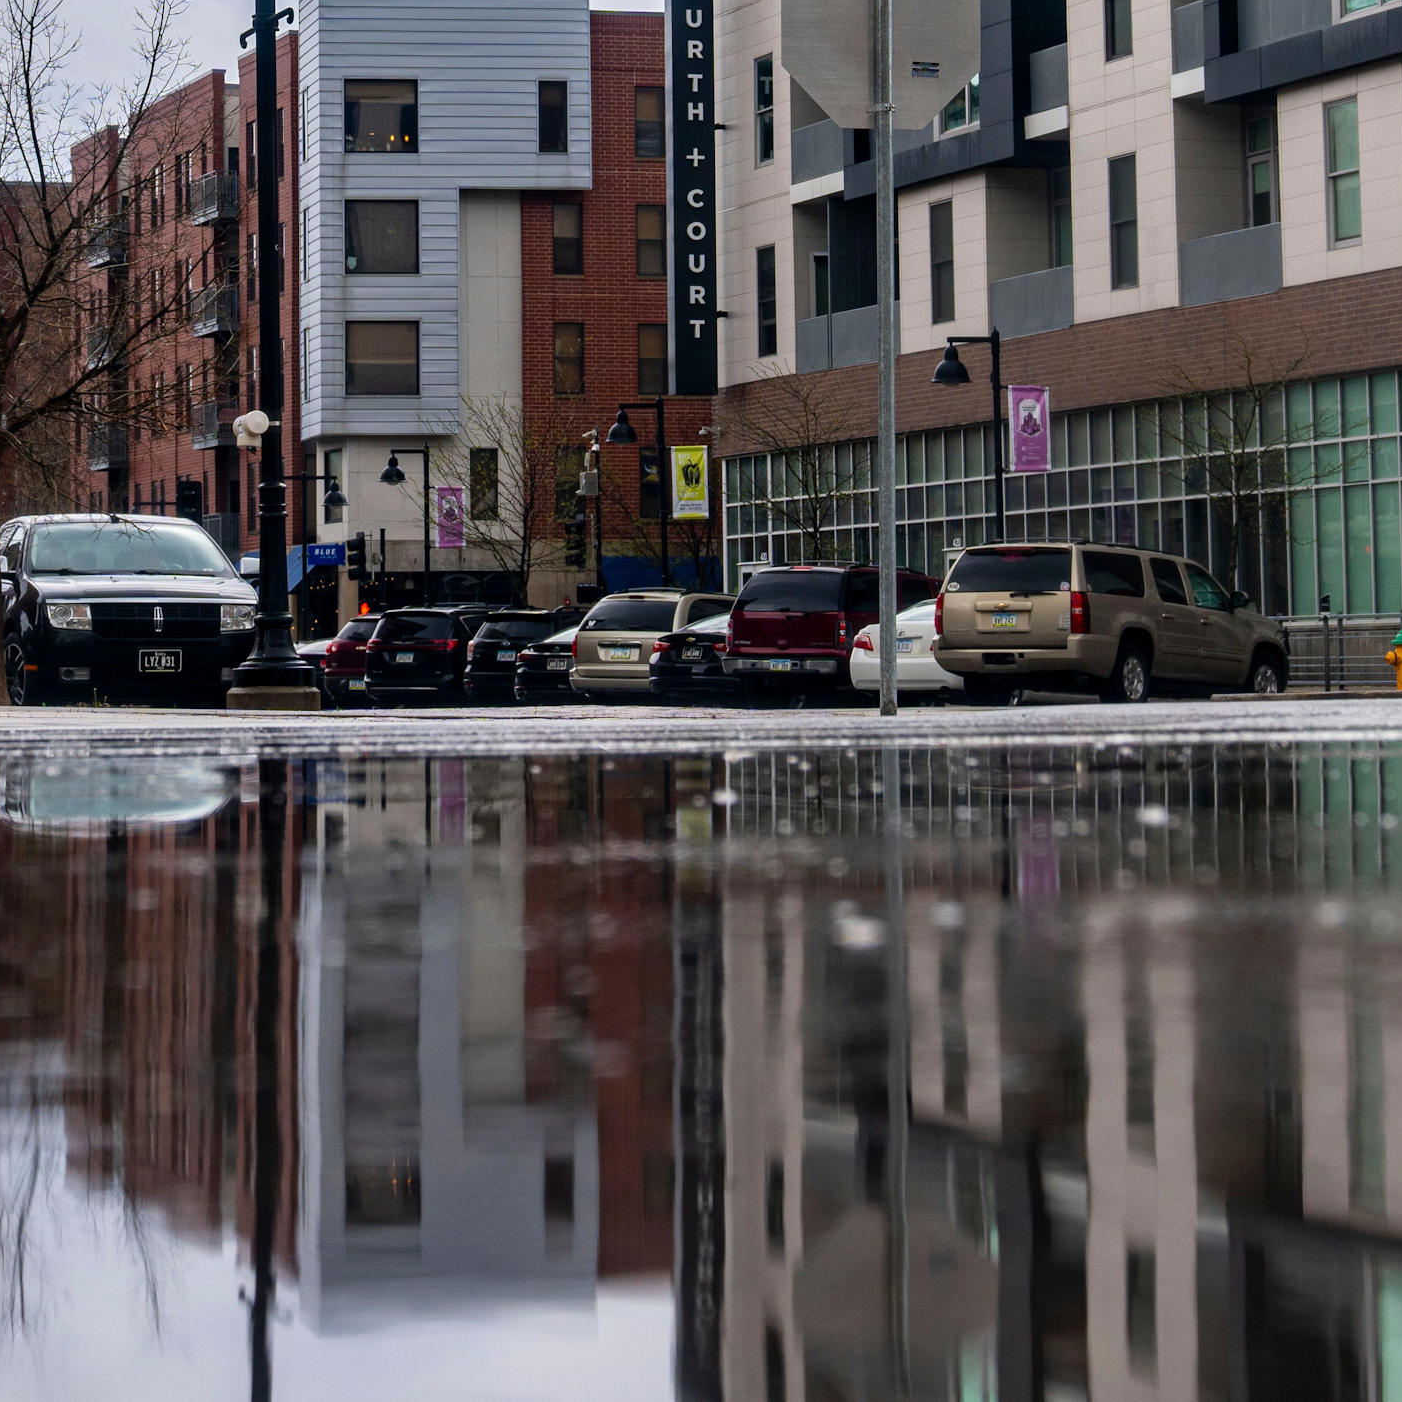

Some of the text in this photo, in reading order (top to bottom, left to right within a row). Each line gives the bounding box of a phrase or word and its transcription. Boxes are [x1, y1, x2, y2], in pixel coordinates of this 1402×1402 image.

[686, 188, 707, 339] COURT
[314, 548, 337, 556] BLUE
[144, 656, 158, 667] LYZ
